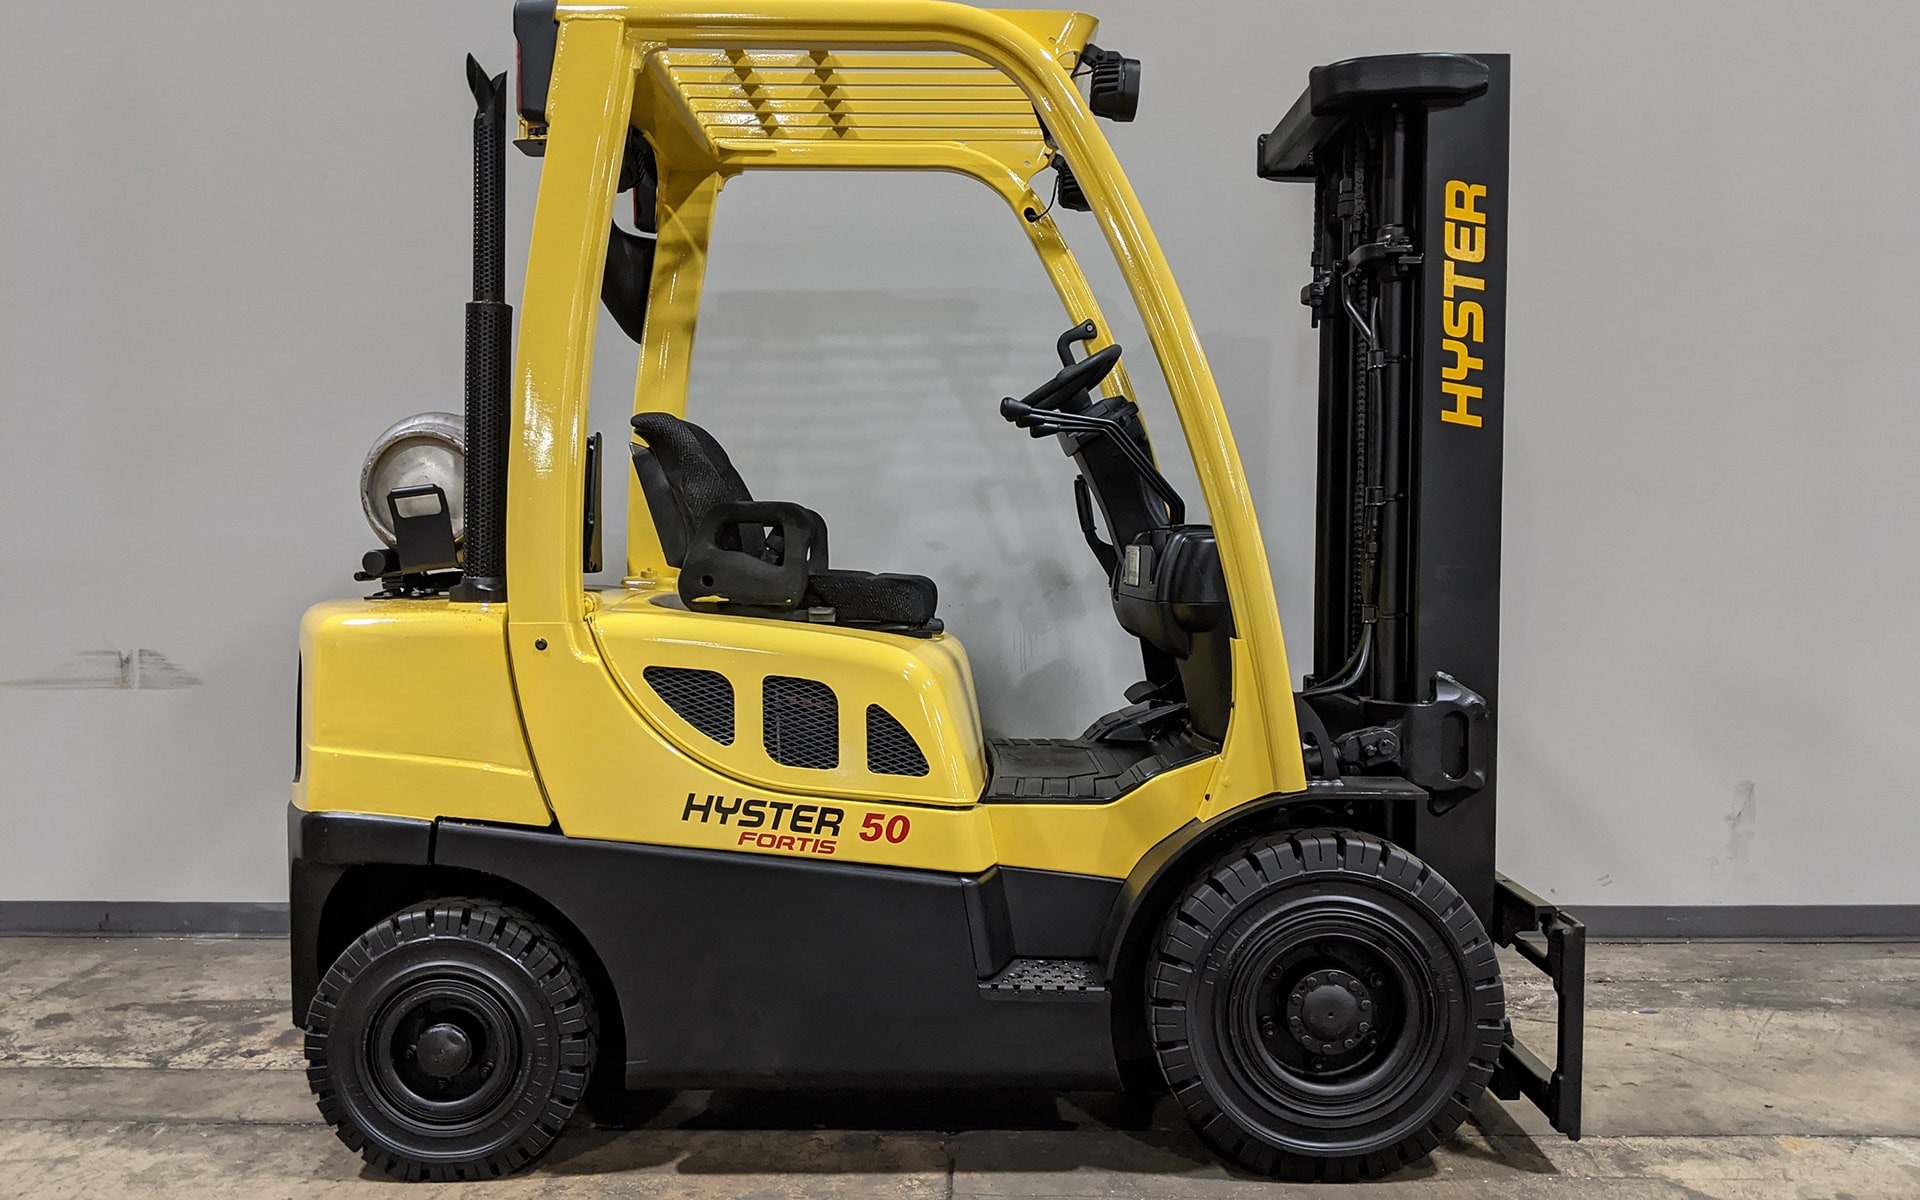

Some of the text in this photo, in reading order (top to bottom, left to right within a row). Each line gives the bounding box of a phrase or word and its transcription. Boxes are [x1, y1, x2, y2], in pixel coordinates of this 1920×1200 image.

[1441, 180, 1487, 428] HYSTER
[682, 793, 911, 844] HYSTER 50
[738, 832, 837, 855] FORTIS
